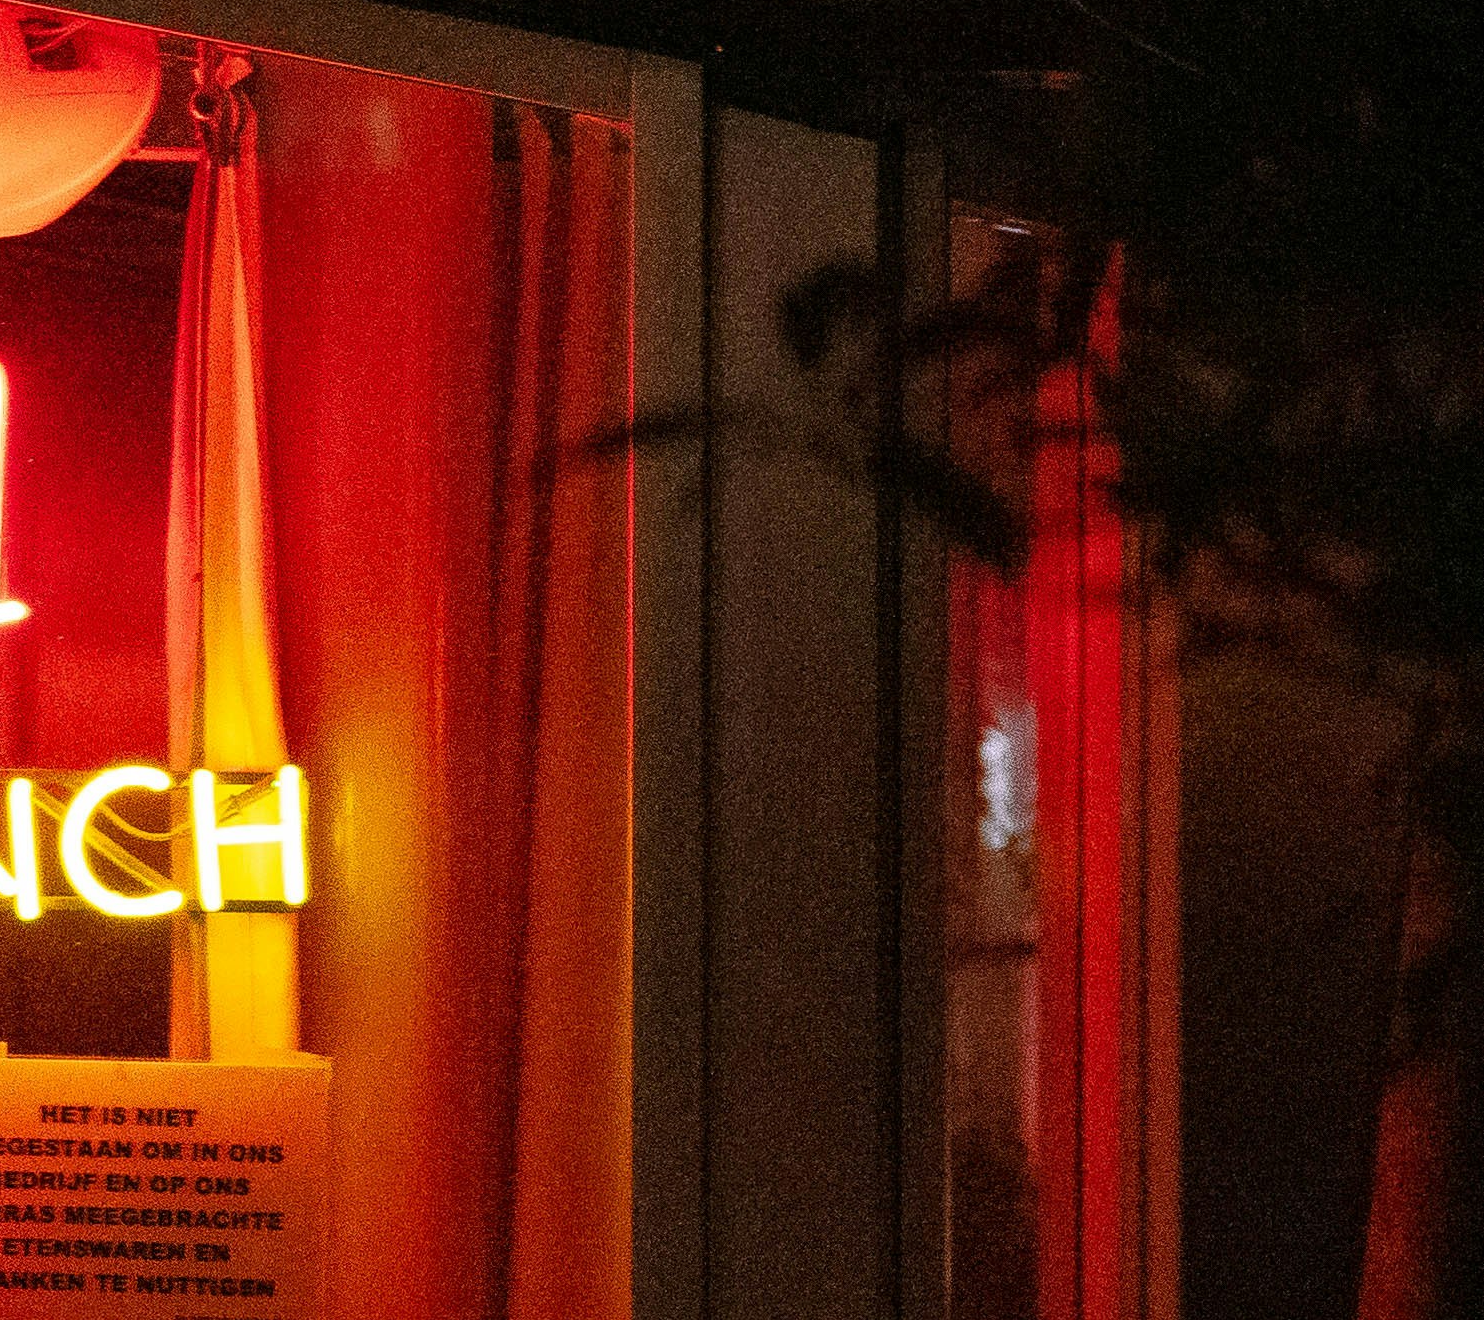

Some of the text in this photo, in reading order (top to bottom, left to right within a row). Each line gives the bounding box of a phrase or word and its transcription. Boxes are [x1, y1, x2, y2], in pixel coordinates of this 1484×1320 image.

[40, 1104, 197, 1127] HET IS NIET
[142, 1141, 183, 1160] OM
[192, 1143, 219, 1161] IN
[229, 1143, 285, 1163] ONS
[106, 1173, 140, 1193] EN
[149, 1175, 186, 1194] OP
[195, 1176, 250, 1196] ONS
[64, 1205, 285, 1231] MEEGEBRACHTE
[2, 1237, 231, 1263] ETENSWAREN EN
[95, 1273, 128, 1293] TE
[136, 1275, 277, 1298] NUTTIGEN
